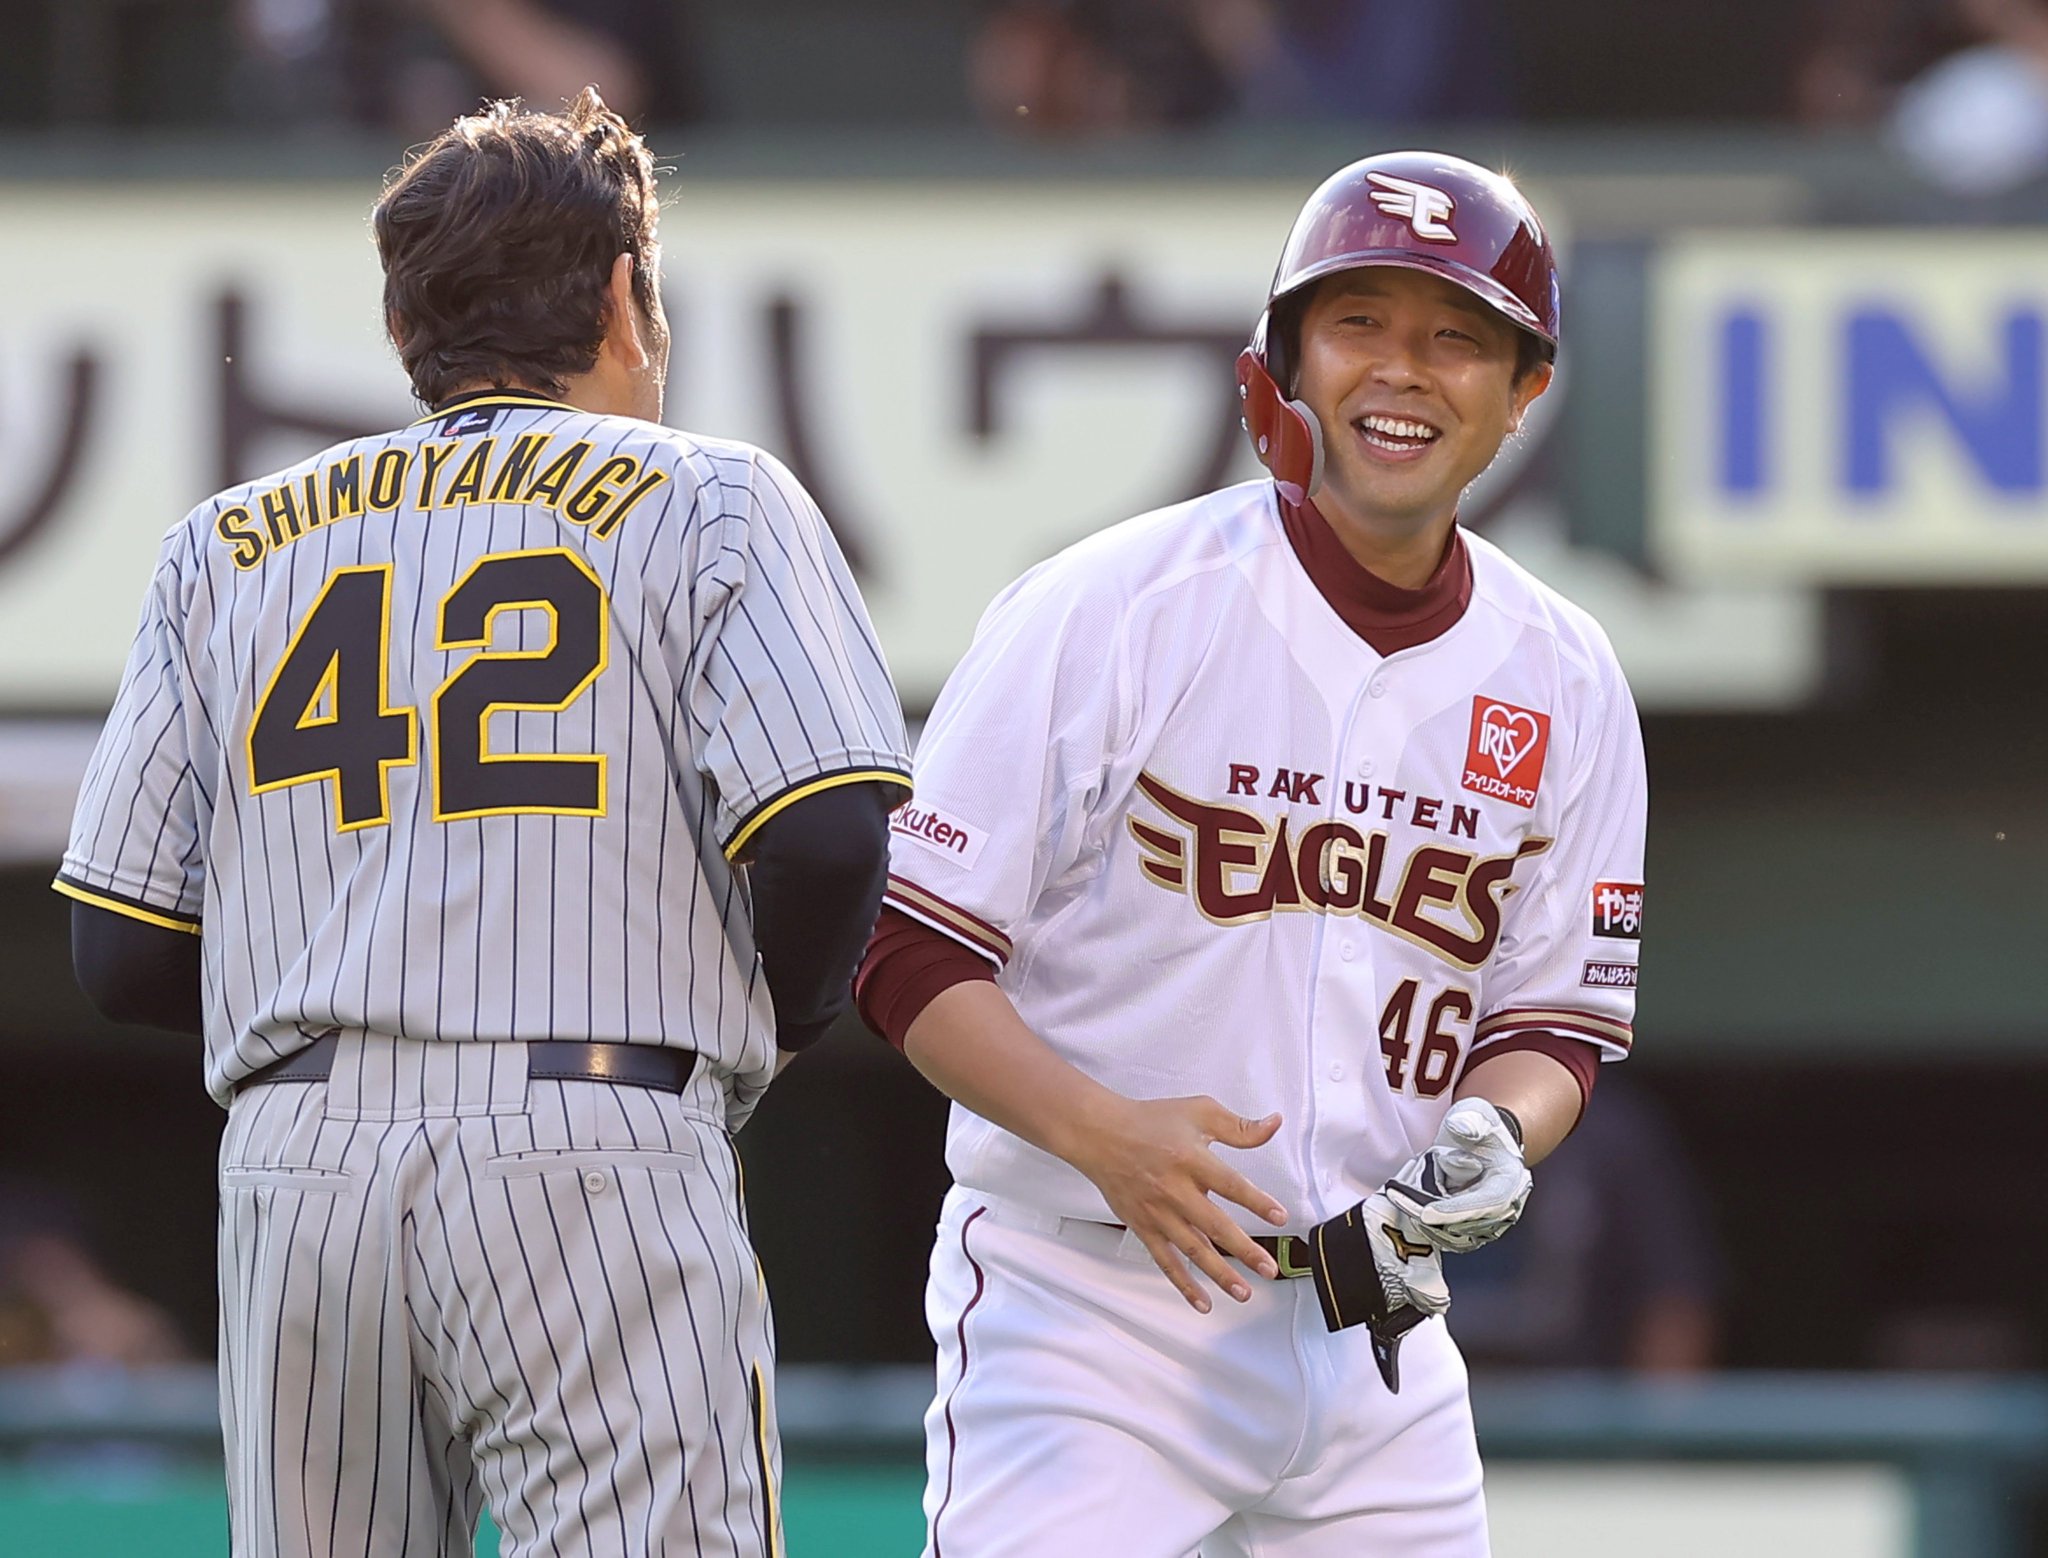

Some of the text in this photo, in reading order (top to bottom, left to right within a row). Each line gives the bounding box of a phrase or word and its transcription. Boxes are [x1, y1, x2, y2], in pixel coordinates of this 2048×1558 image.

[216, 433, 669, 572] SHIMOYANAGI
[246, 546, 610, 834] 42
[1478, 719, 1519, 762] IRIS
[1227, 763, 1481, 839] RAKUTEN
[1463, 770, 1535, 805] アイリスオーヤマ
[892, 800, 969, 854] kuten
[1127, 770, 1556, 972] EAGLES
[1597, 887, 1644, 934] やま
[1378, 976, 1476, 1100] 46
